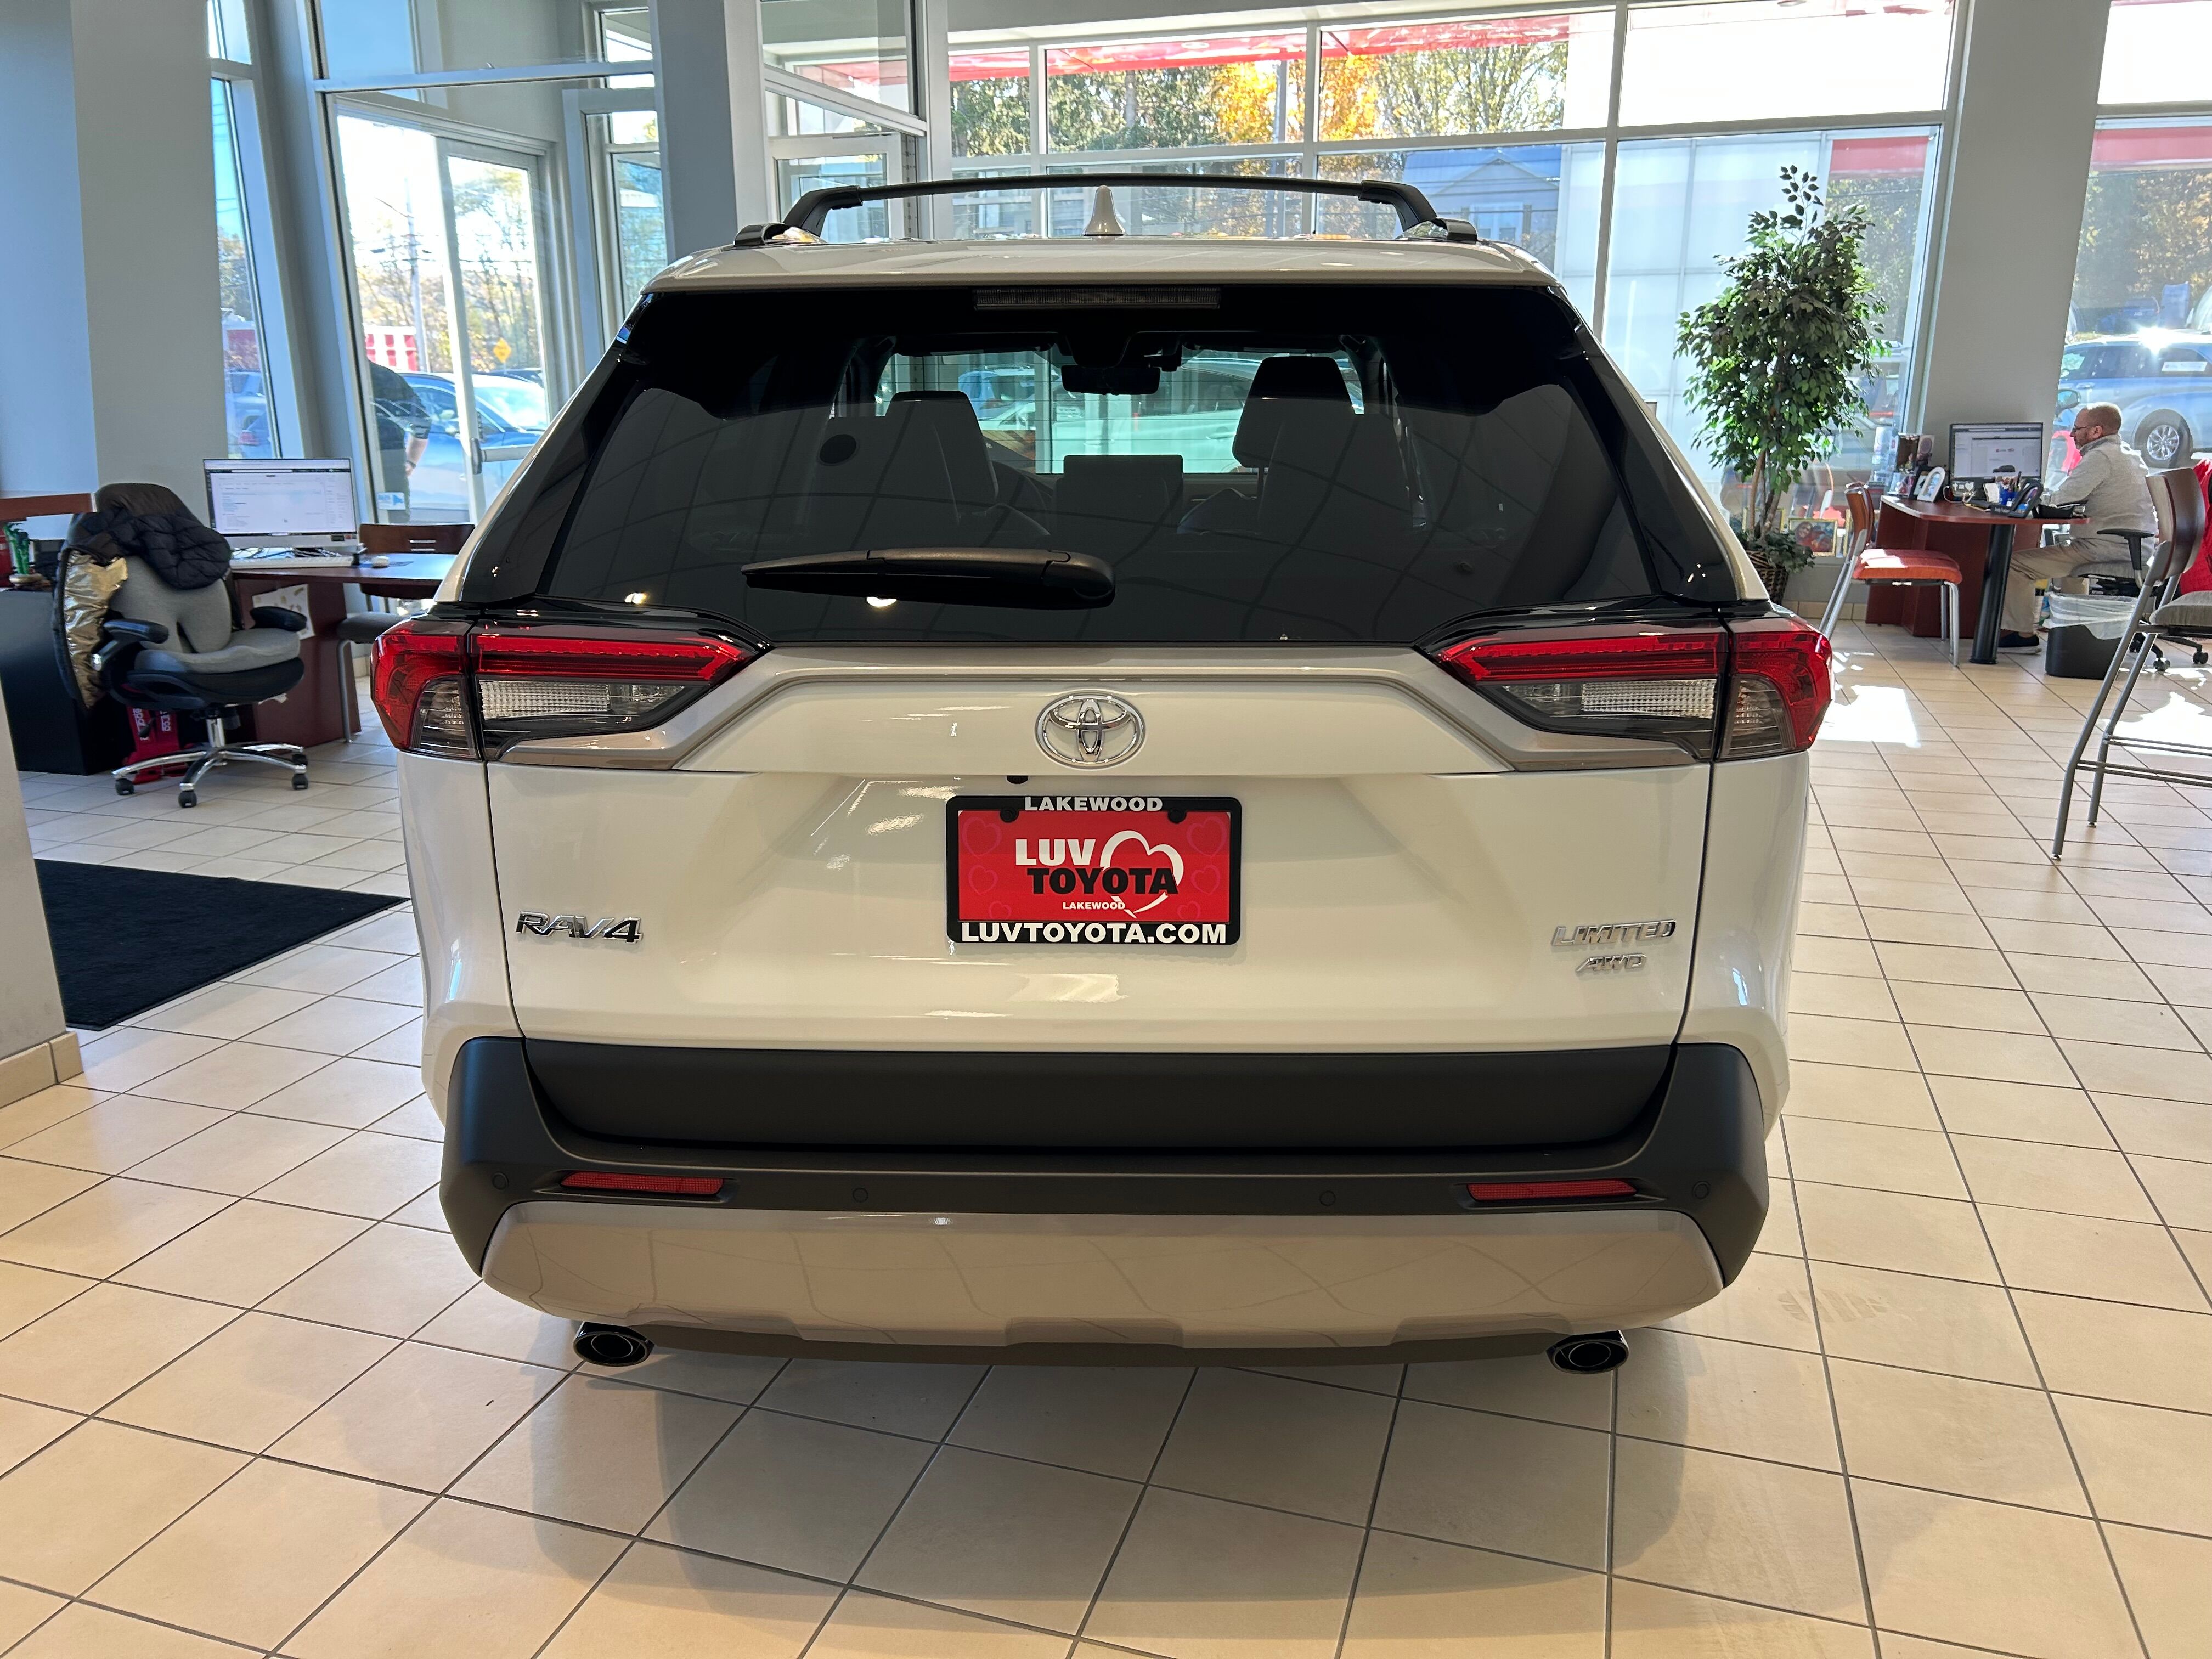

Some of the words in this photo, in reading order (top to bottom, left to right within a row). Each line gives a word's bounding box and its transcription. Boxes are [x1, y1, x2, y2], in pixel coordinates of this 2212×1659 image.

[1024, 797, 1163, 811] LAKEWOOD
[1015, 839, 1096, 865] LUV
[1027, 868, 1178, 894] TOYOTA
[1062, 901, 1126, 910] LAKEWOOD
[515, 910, 644, 944] RAV4
[961, 922, 1227, 944] LUVTOYOTA.COM
[1550, 919, 1677, 946] LIMITED
[1576, 952, 1647, 972] AWD
